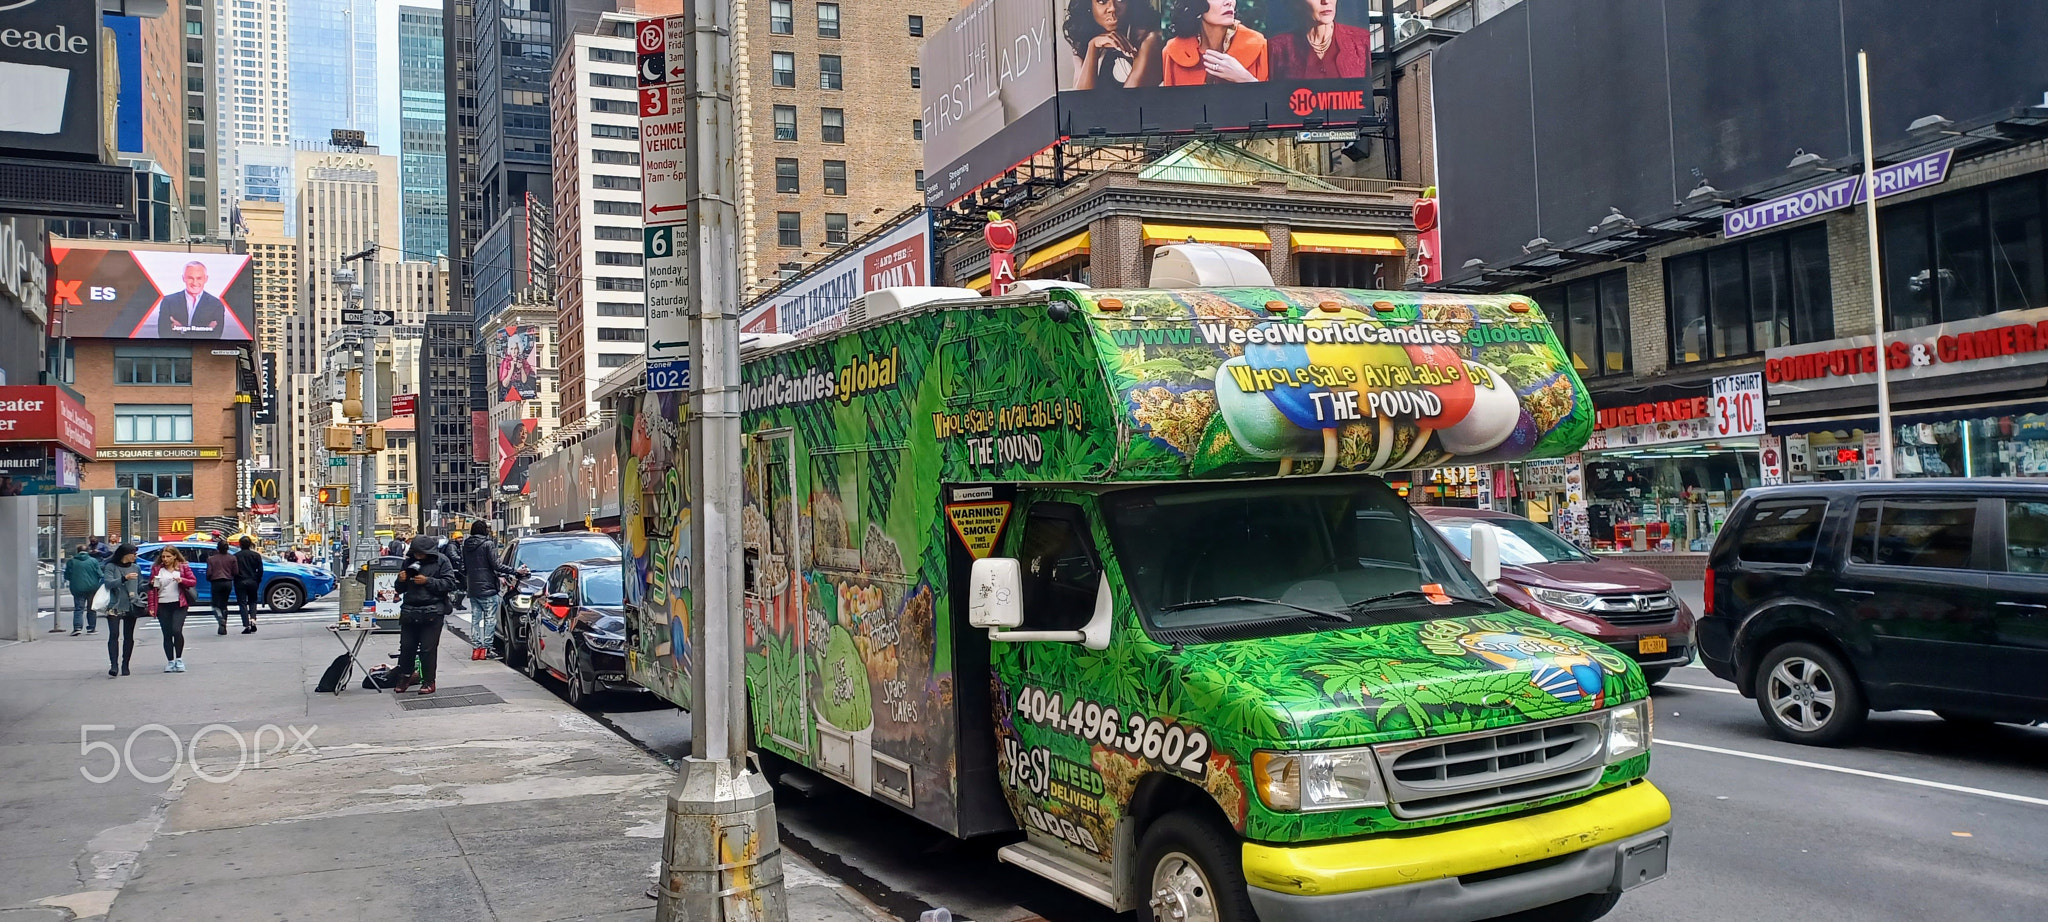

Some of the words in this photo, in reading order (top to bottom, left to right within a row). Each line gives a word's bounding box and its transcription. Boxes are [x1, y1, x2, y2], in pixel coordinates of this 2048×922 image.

[0, 25, 88, 54] eade
[668, 31, 684, 39] Wed
[669, 54, 684, 62] 3am
[968, 42, 987, 64] THE
[922, 72, 975, 144] FIRST
[985, 17, 1046, 99] LADY
[647, 88, 661, 114] 3
[1289, 88, 1365, 116] SHOWTIME
[647, 159, 677, 170] Monday
[1871, 157, 1941, 192] PRIME
[648, 173, 664, 182] 7am
[926, 183, 939, 195] Series
[1728, 182, 1850, 234] OUTFRONT
[651, 229, 666, 256] 6
[879, 254, 893, 268] AND
[893, 248, 907, 263] THE
[650, 265, 682, 276] Monday
[870, 260, 917, 291] TOWN
[90, 286, 116, 301] ES
[650, 278, 668, 290] 6pm
[650, 294, 688, 307] Saturday
[781, 296, 806, 334] HUGH
[808, 267, 857, 326] JACKMAN
[650, 309, 668, 318] 8am
[1912, 343, 1930, 367] &
[649, 369, 689, 388] 1022
[1465, 364, 1496, 390] by
[1716, 378, 1728, 394] NY
[0, 398, 44, 412] eater
[1065, 397, 1083, 432] by
[1309, 391, 1361, 421] THE
[1369, 389, 1443, 419] POUND
[1594, 396, 1710, 430] LUGGAGE
[1717, 396, 1730, 436] 3
[119, 450, 154, 458] SQUARE
[163, 449, 197, 457] CHURCH
[967, 436, 995, 465] THE
[998, 433, 1043, 465] POUND
[951, 506, 1004, 519] WARNING!
[975, 518, 995, 526] Attempt
[963, 525, 996, 536] SMOKE
[1017, 687, 1208, 773] 404.496.3602
[1053, 757, 1102, 796] WEED
[1050, 781, 1100, 814] DELIVER!
